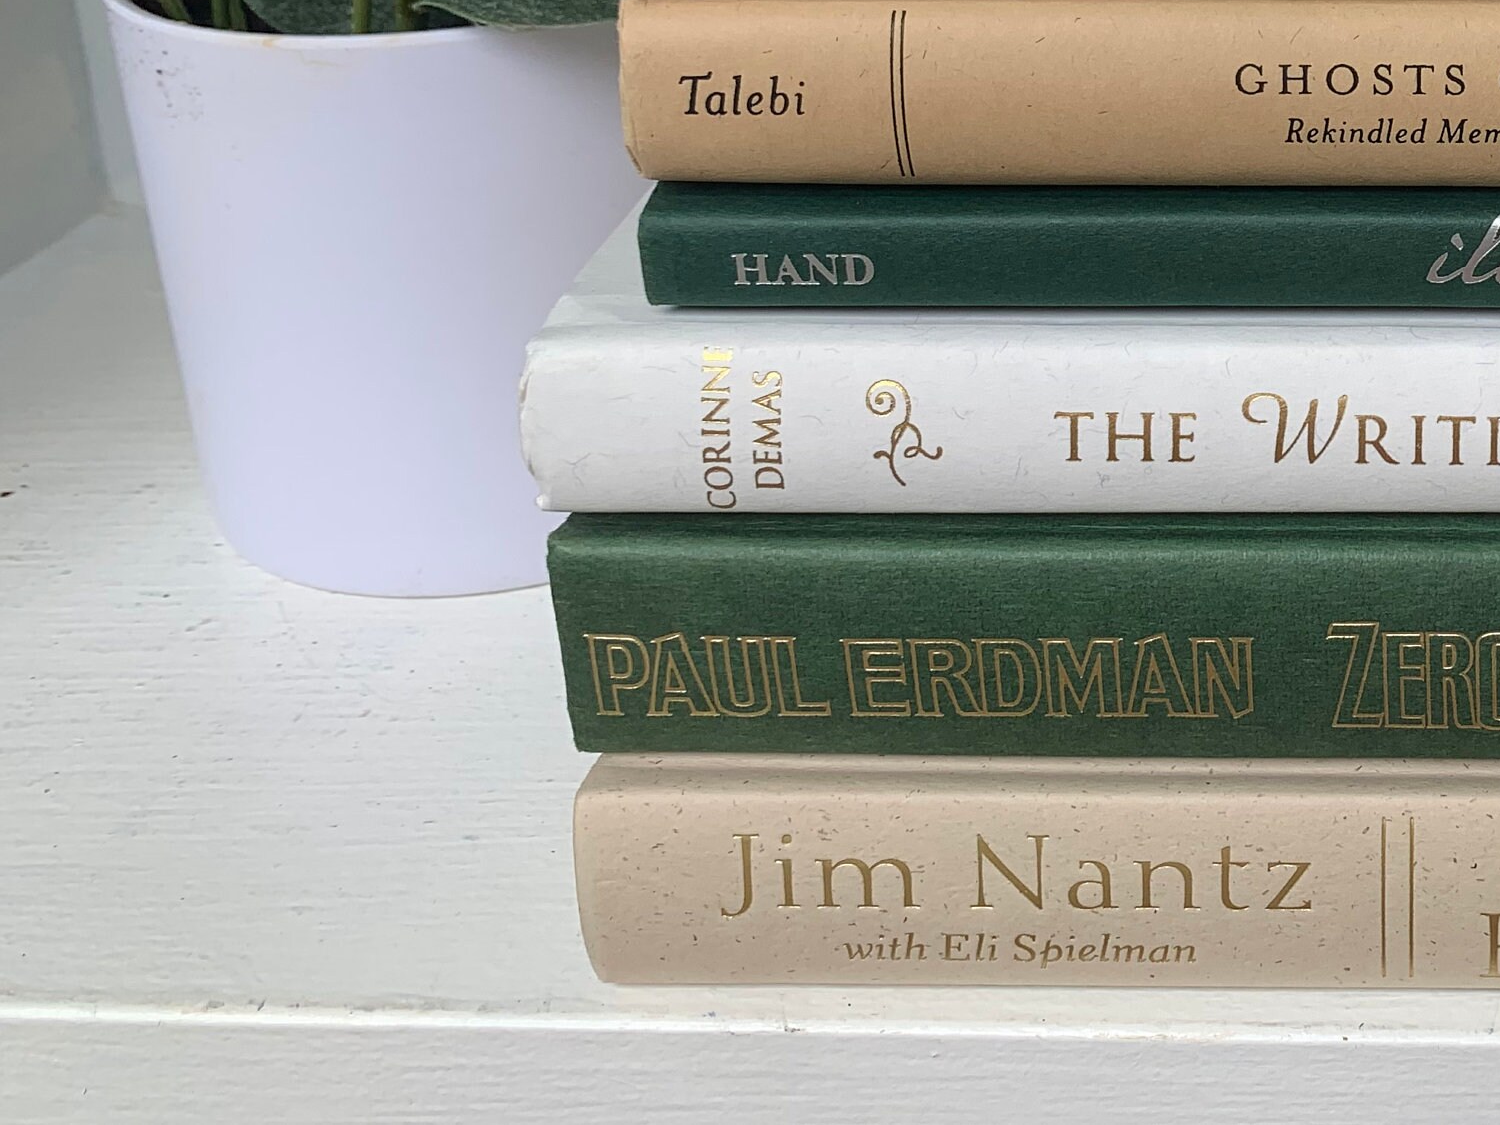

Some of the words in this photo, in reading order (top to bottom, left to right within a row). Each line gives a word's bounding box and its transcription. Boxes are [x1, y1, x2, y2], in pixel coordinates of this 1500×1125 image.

[678, 72, 806, 117] Talebi
[1233, 63, 1468, 97] GHOSTS
[1285, 117, 1427, 146] Rekindled
[730, 253, 875, 287] HAND
[701, 345, 737, 510] CORINNE
[751, 370, 785, 490] DEMAS
[1054, 411, 1198, 463] THE
[584, 632, 831, 718] PAUL
[839, 632, 1255, 720] ERDMAN
[721, 833, 920, 919] Jim
[970, 833, 1313, 912] Nantz
[843, 932, 927, 962] with
[941, 932, 998, 962] Eli
[1012, 932, 1198, 969] Spielman
